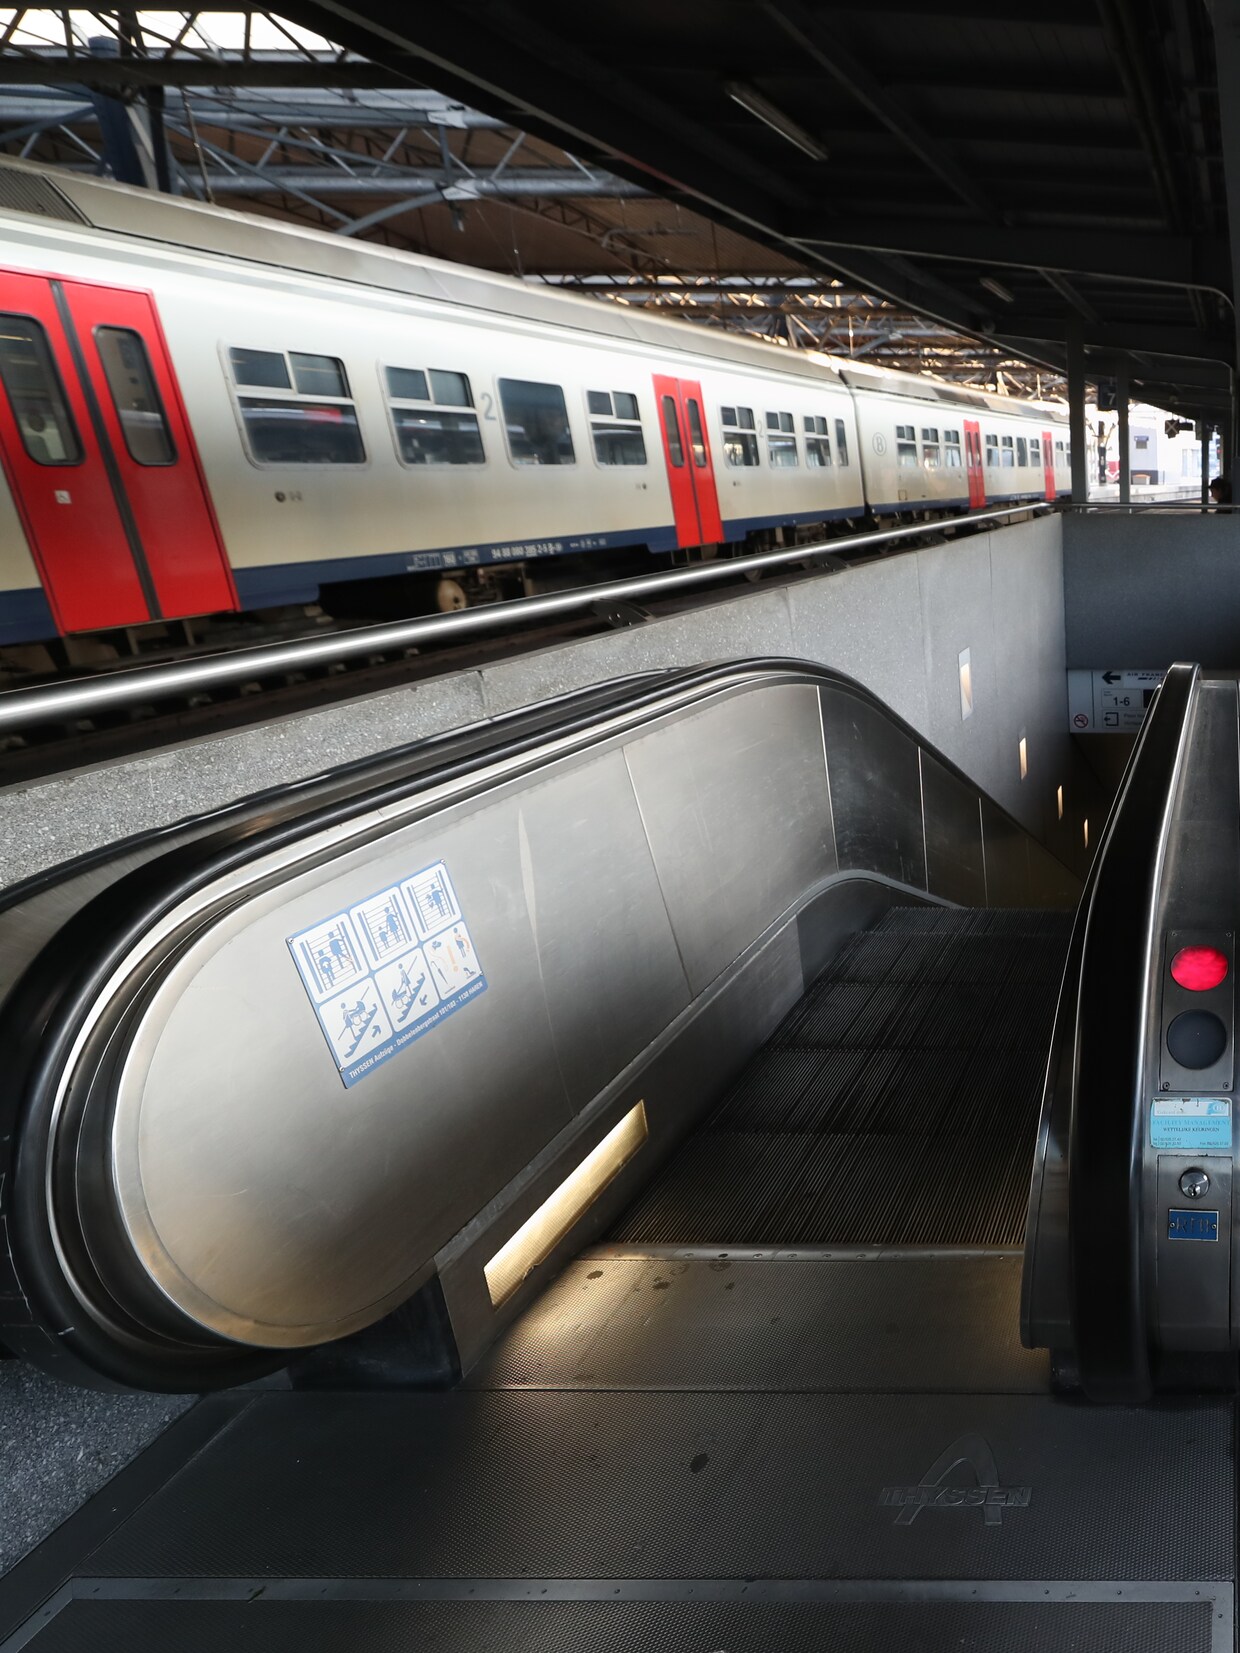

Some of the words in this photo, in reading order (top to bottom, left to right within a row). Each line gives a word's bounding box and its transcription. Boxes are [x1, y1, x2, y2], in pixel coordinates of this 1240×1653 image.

[481, 392, 496, 420] 2
[1108, 392, 1116, 406] 7
[1113, 696, 1130, 706] 1-6
[349, 1058, 374, 1078] THYSSEN
